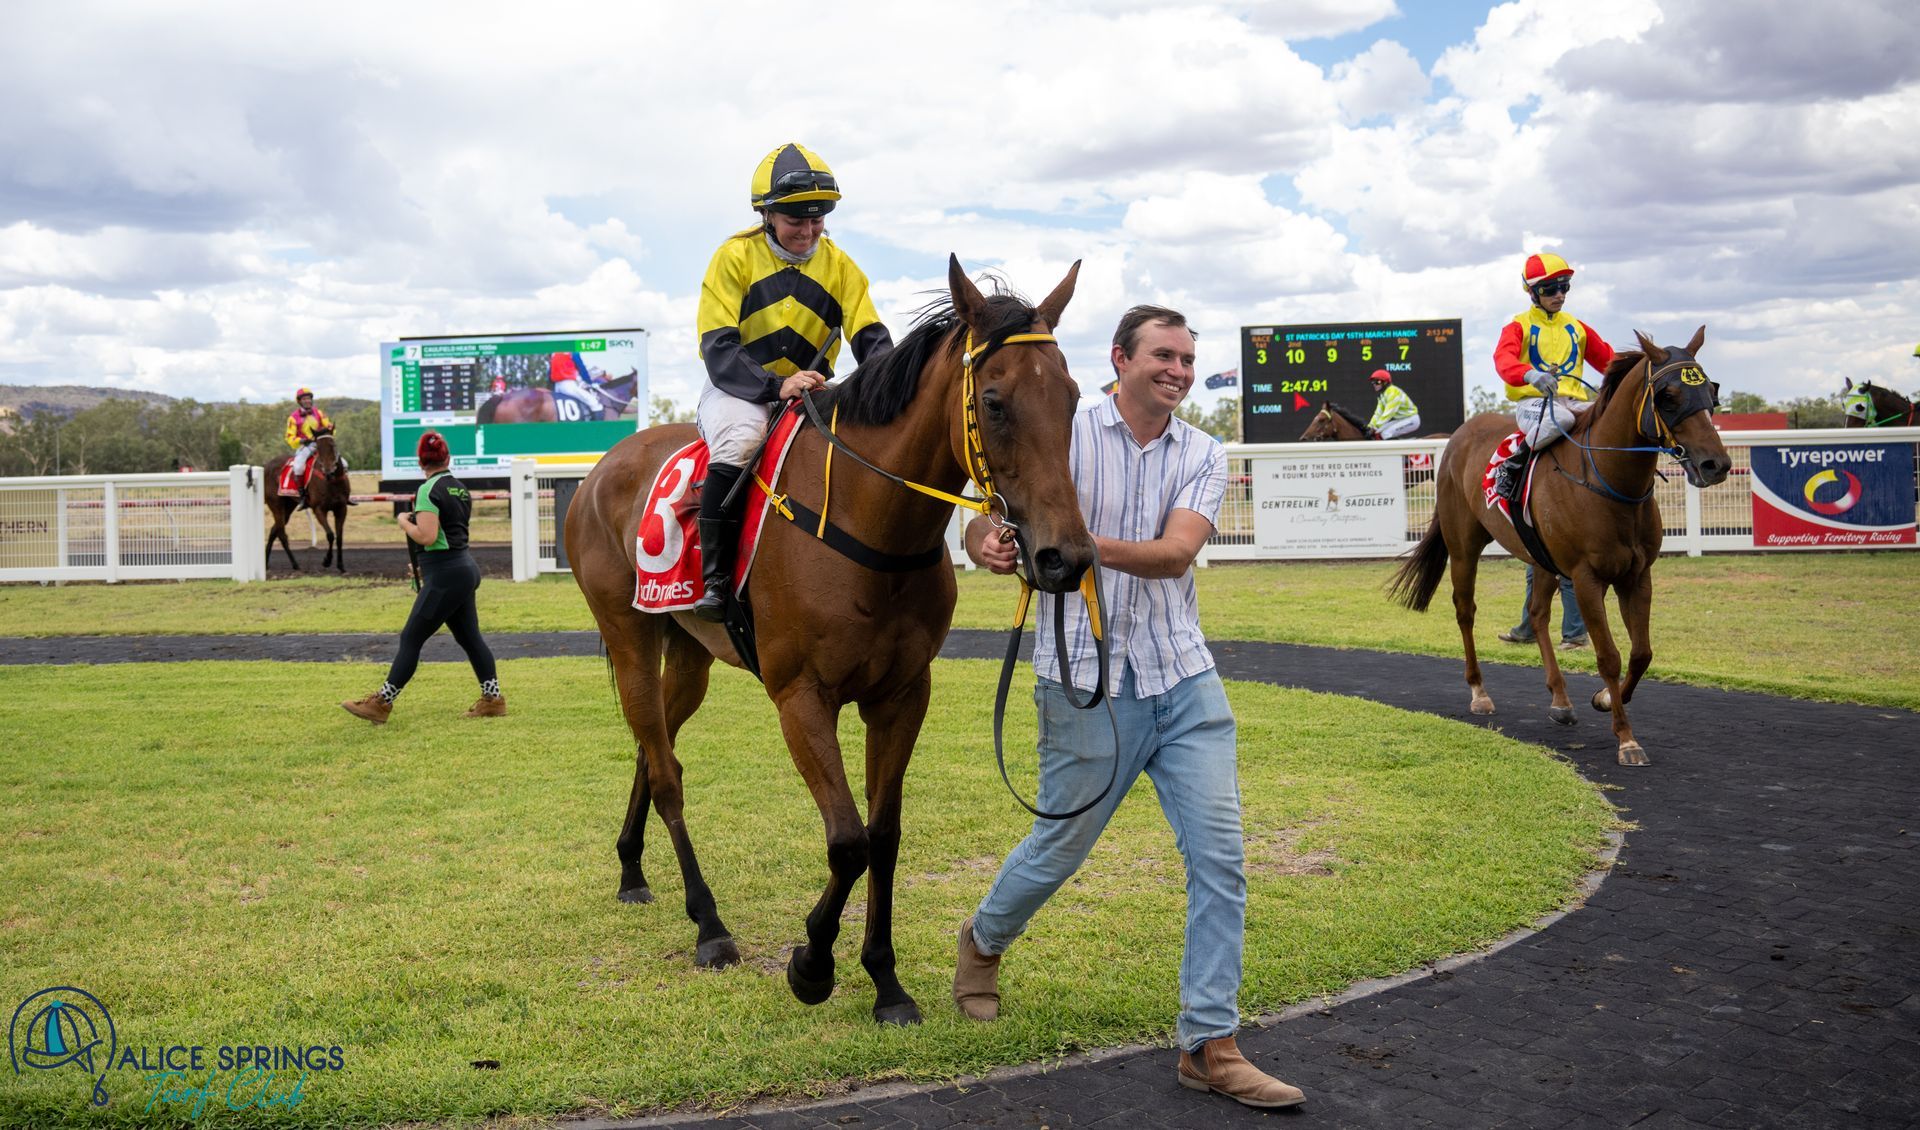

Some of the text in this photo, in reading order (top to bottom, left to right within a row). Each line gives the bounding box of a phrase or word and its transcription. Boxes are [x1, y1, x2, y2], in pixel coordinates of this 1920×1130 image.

[1285, 334, 1295, 342] ST
[1295, 333, 1330, 341] PATRICKS
[1331, 332, 1345, 340] DAY
[1364, 330, 1391, 339] MARCH
[581, 341, 602, 350] 1:47
[409, 347, 418, 357] 7
[1257, 345, 1410, 365] 3 10 9 5 7
[1385, 362, 1412, 371] TRACK
[1252, 379, 1328, 393] TIME 2:47.91
[556, 398, 580, 422] 10
[1777, 447, 1885, 467] Tyrepower
[1345, 462, 1372, 470] CENTRE
[1349, 470, 1383, 478] SERVICES
[1261, 497, 1395, 509] CENTRELINE SADDLERY
[636, 457, 696, 574] 3
[1767, 531, 1902, 545] Supporting Territory Racing
